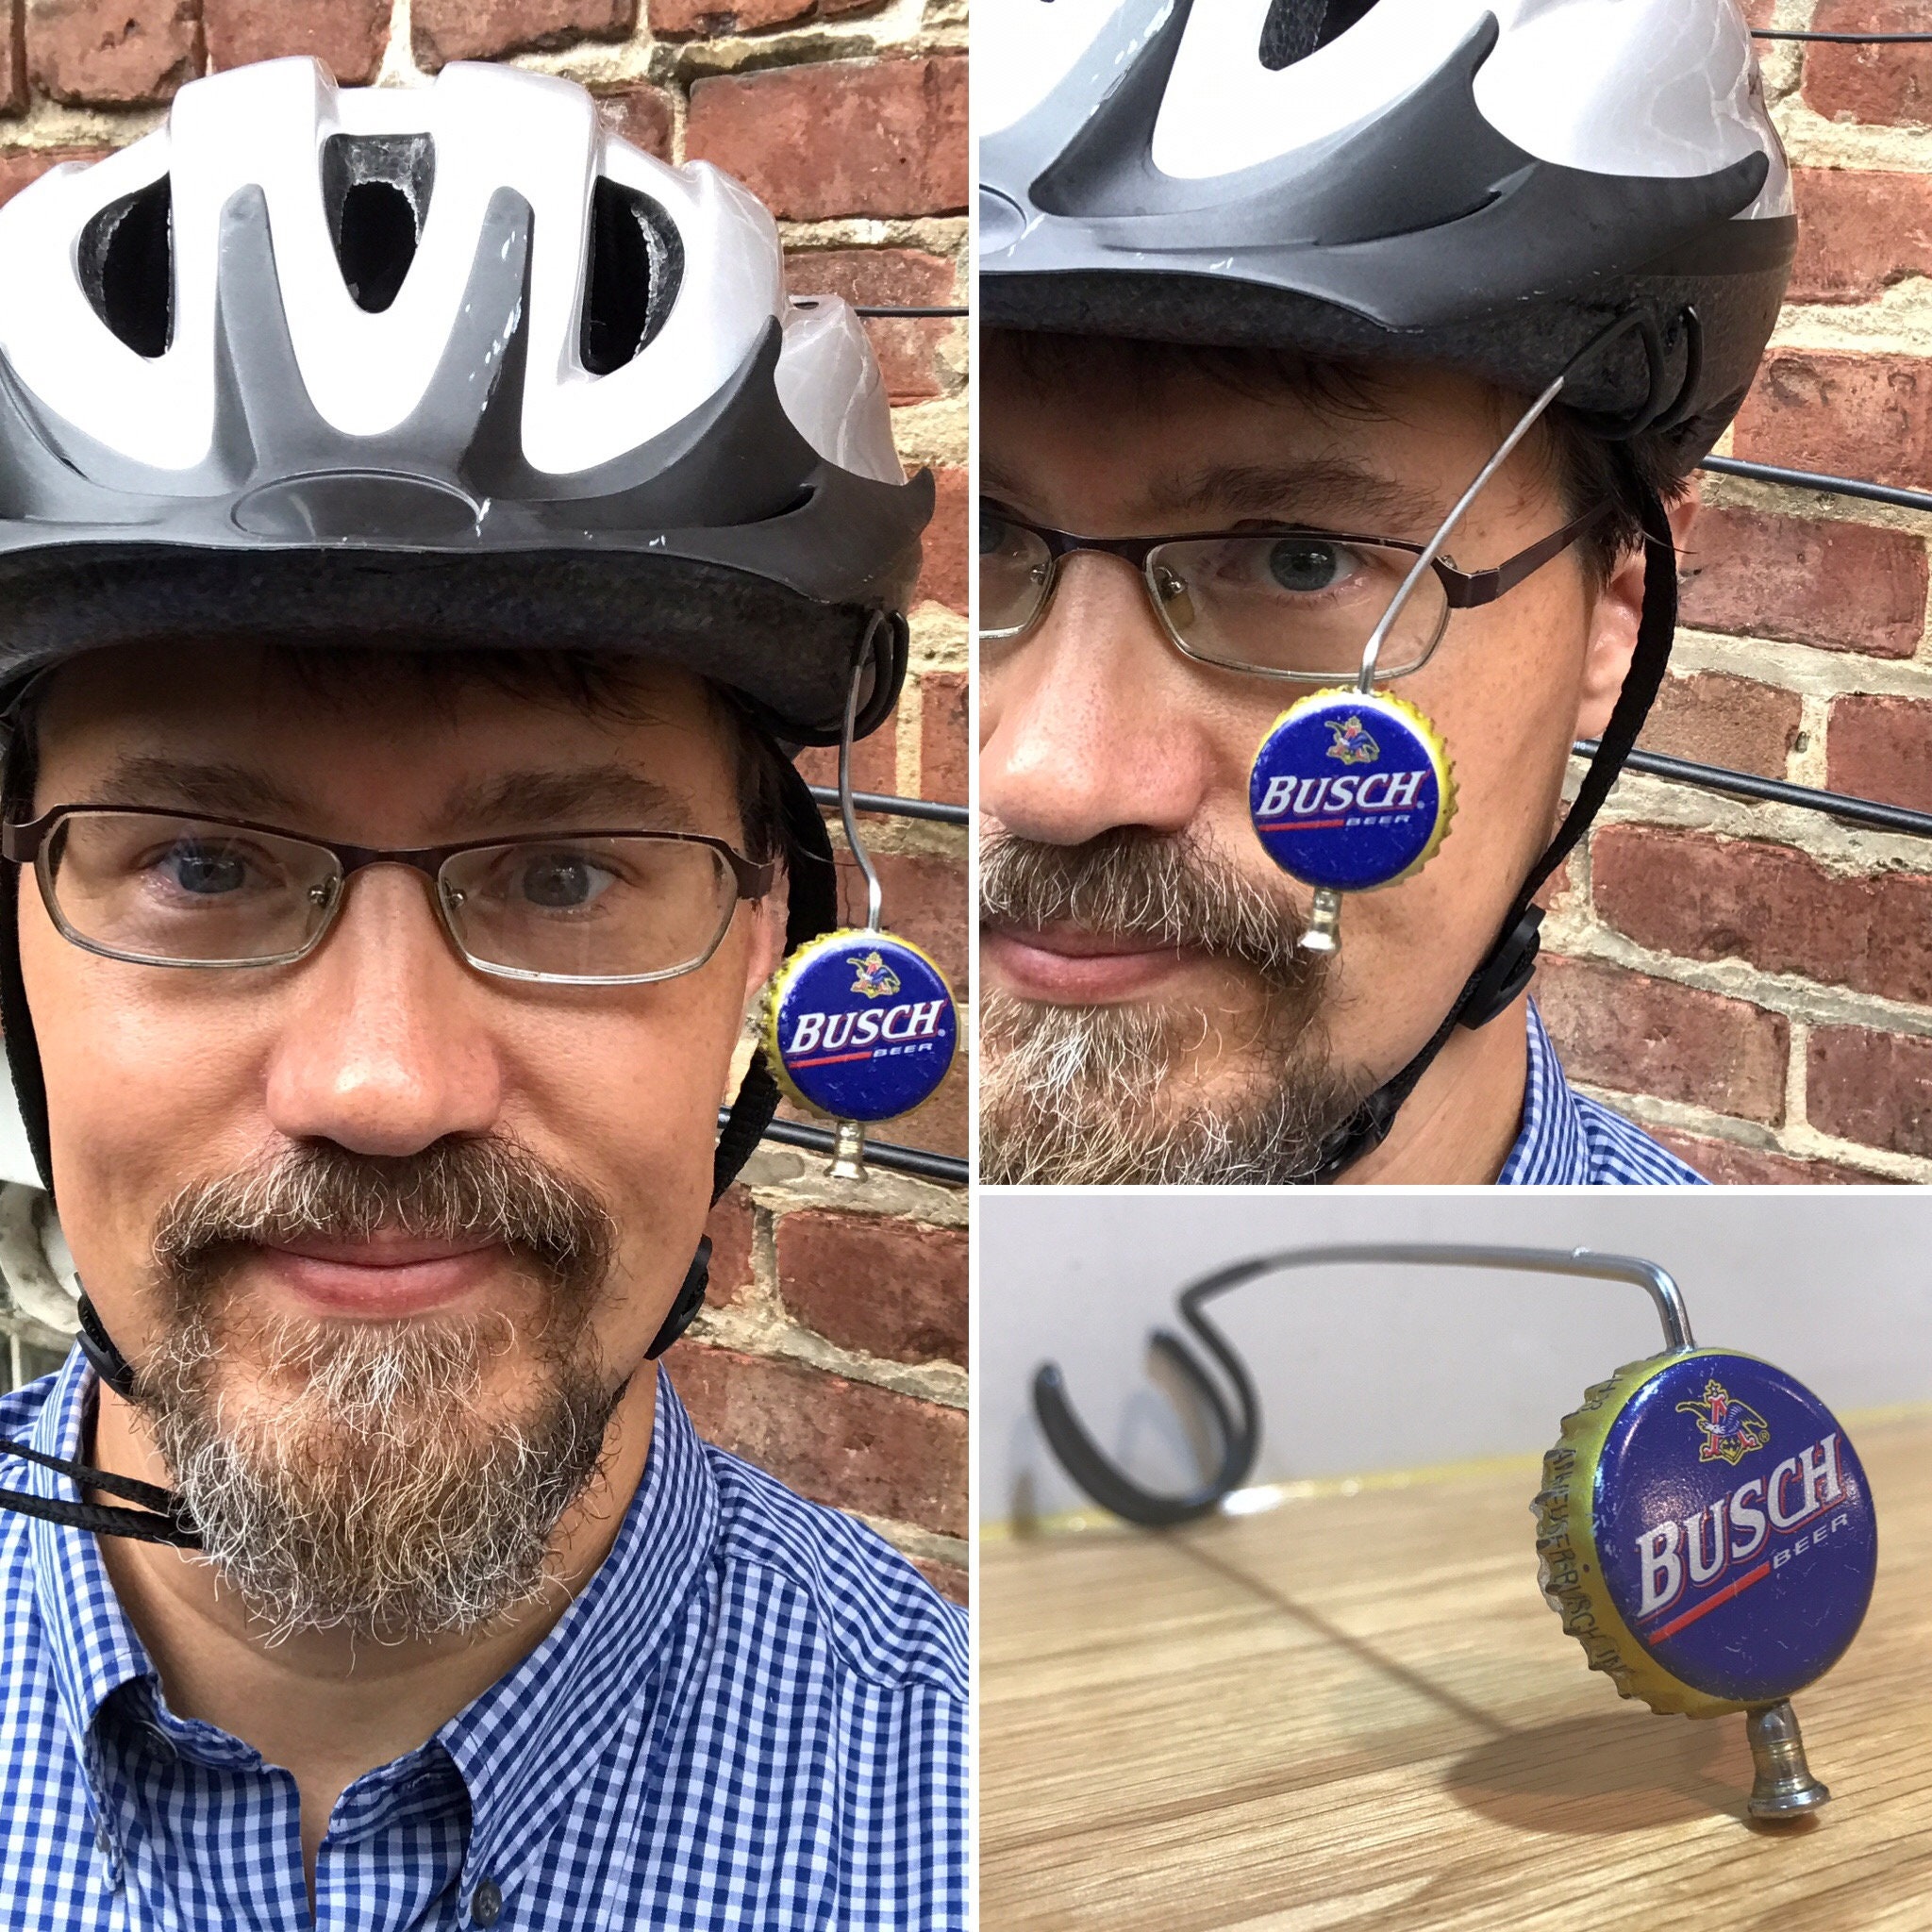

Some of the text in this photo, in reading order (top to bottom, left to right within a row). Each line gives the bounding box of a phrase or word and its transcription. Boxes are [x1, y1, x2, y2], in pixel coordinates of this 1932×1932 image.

[1256, 770, 1426, 816] BUSCH
[1346, 814, 1410, 826] BEER
[786, 998, 946, 1055] BUSCH
[873, 1042, 933, 1058] BEER
[1635, 1432, 1844, 1621] BUSCH
[1773, 1512, 1848, 1570] BEER
